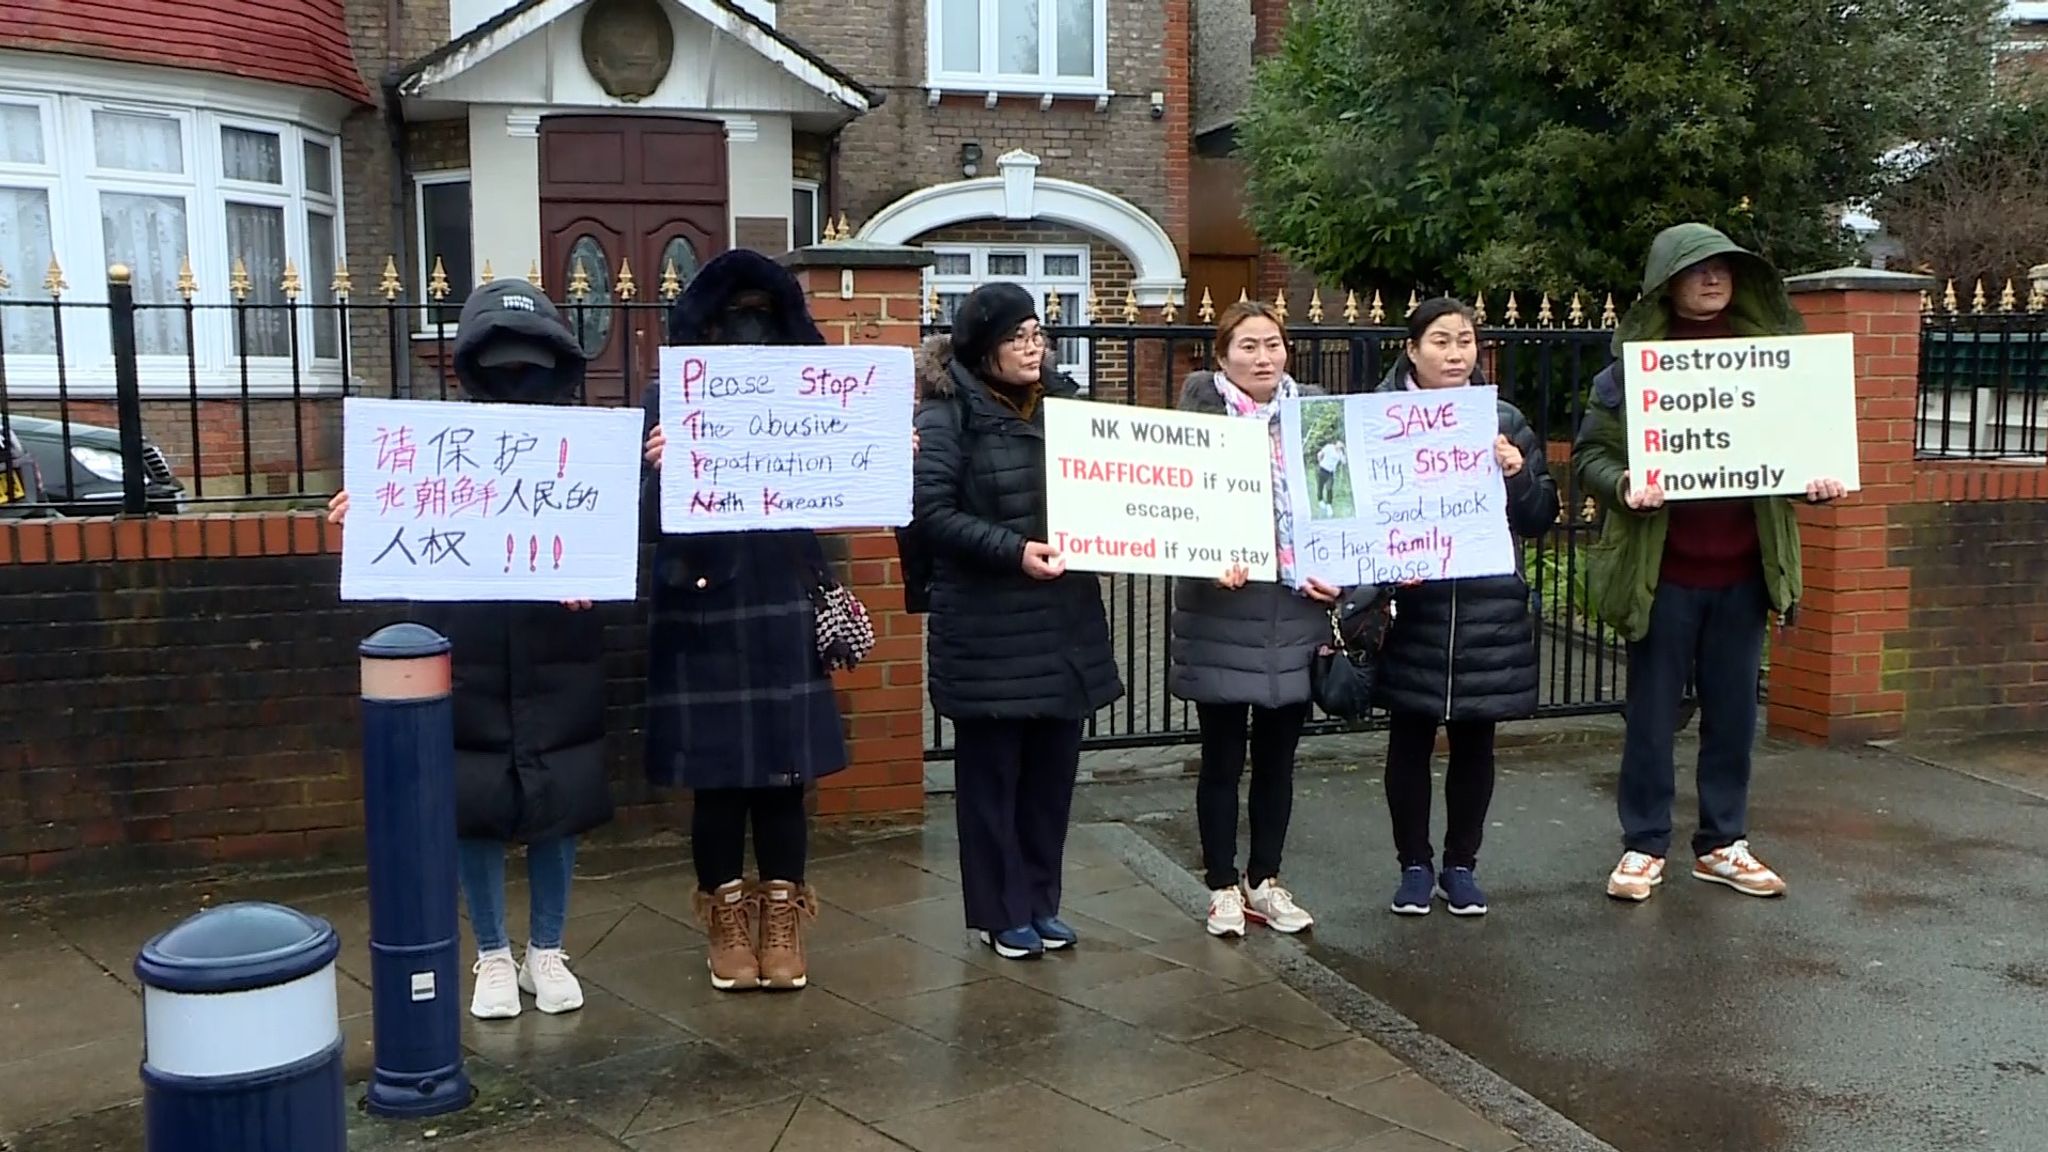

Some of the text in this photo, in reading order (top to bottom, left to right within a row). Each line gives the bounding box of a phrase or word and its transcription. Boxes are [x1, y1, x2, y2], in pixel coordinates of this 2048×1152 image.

[1641, 345, 1790, 372] Destroying
[683, 359, 876, 407] Please Stop!
[1642, 386, 1756, 413] People's
[683, 409, 848, 440] The abusive
[1091, 418, 1120, 440] NK
[1131, 421, 1211, 448] WOMEN
[1384, 402, 1457, 440] SAVE
[1644, 428, 1731, 453] Rights
[690, 445, 880, 486] repatriation of
[1057, 457, 1262, 494] TRAFFICKED if you
[1371, 445, 1492, 494] My Sister,
[1646, 464, 1785, 491] Knowingly
[763, 487, 844, 515] Koreans
[1125, 502, 1200, 522] escape,
[1376, 492, 1489, 525] Send back
[1054, 532, 1270, 567] Tortured if you stay
[1341, 531, 1378, 559] her
[1386, 526, 1453, 561] family
